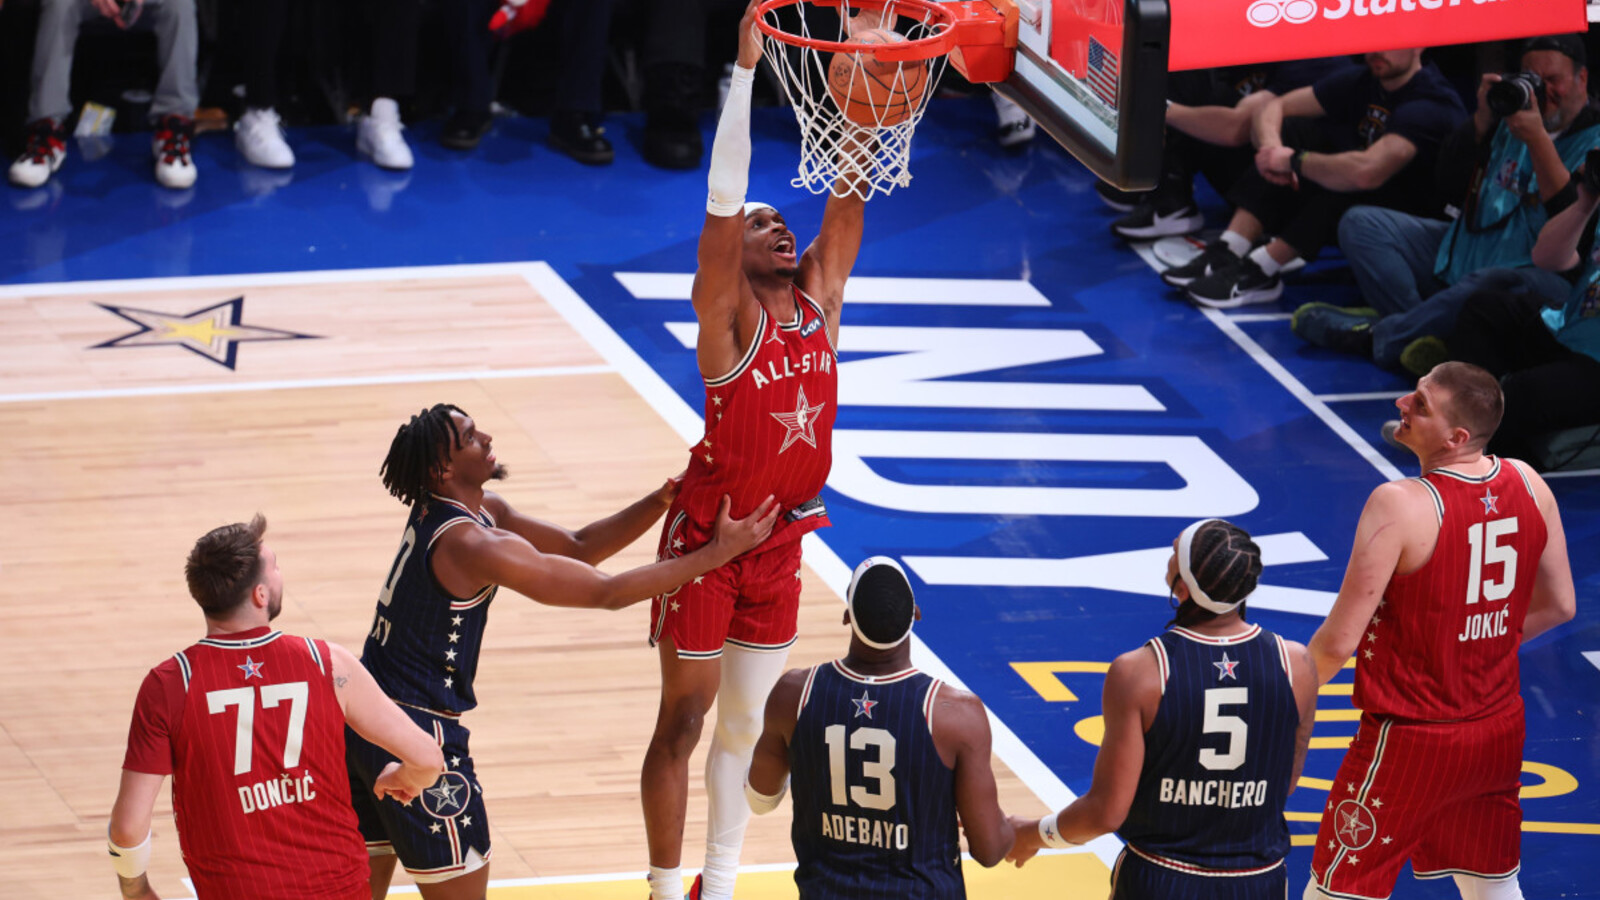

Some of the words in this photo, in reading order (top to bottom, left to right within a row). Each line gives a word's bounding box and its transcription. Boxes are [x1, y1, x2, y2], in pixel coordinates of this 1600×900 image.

[751, 350, 832, 390] ALL-STAR
[1466, 516, 1518, 605] 15
[1458, 603, 1509, 642] JOKIĆ
[206, 681, 309, 776] 77
[1198, 687, 1248, 770] 5
[824, 724, 896, 811] 13
[237, 769, 316, 815] DONČIĆ
[1159, 778, 1268, 809] BANCHERO
[821, 812, 909, 850] ADEBAYO
